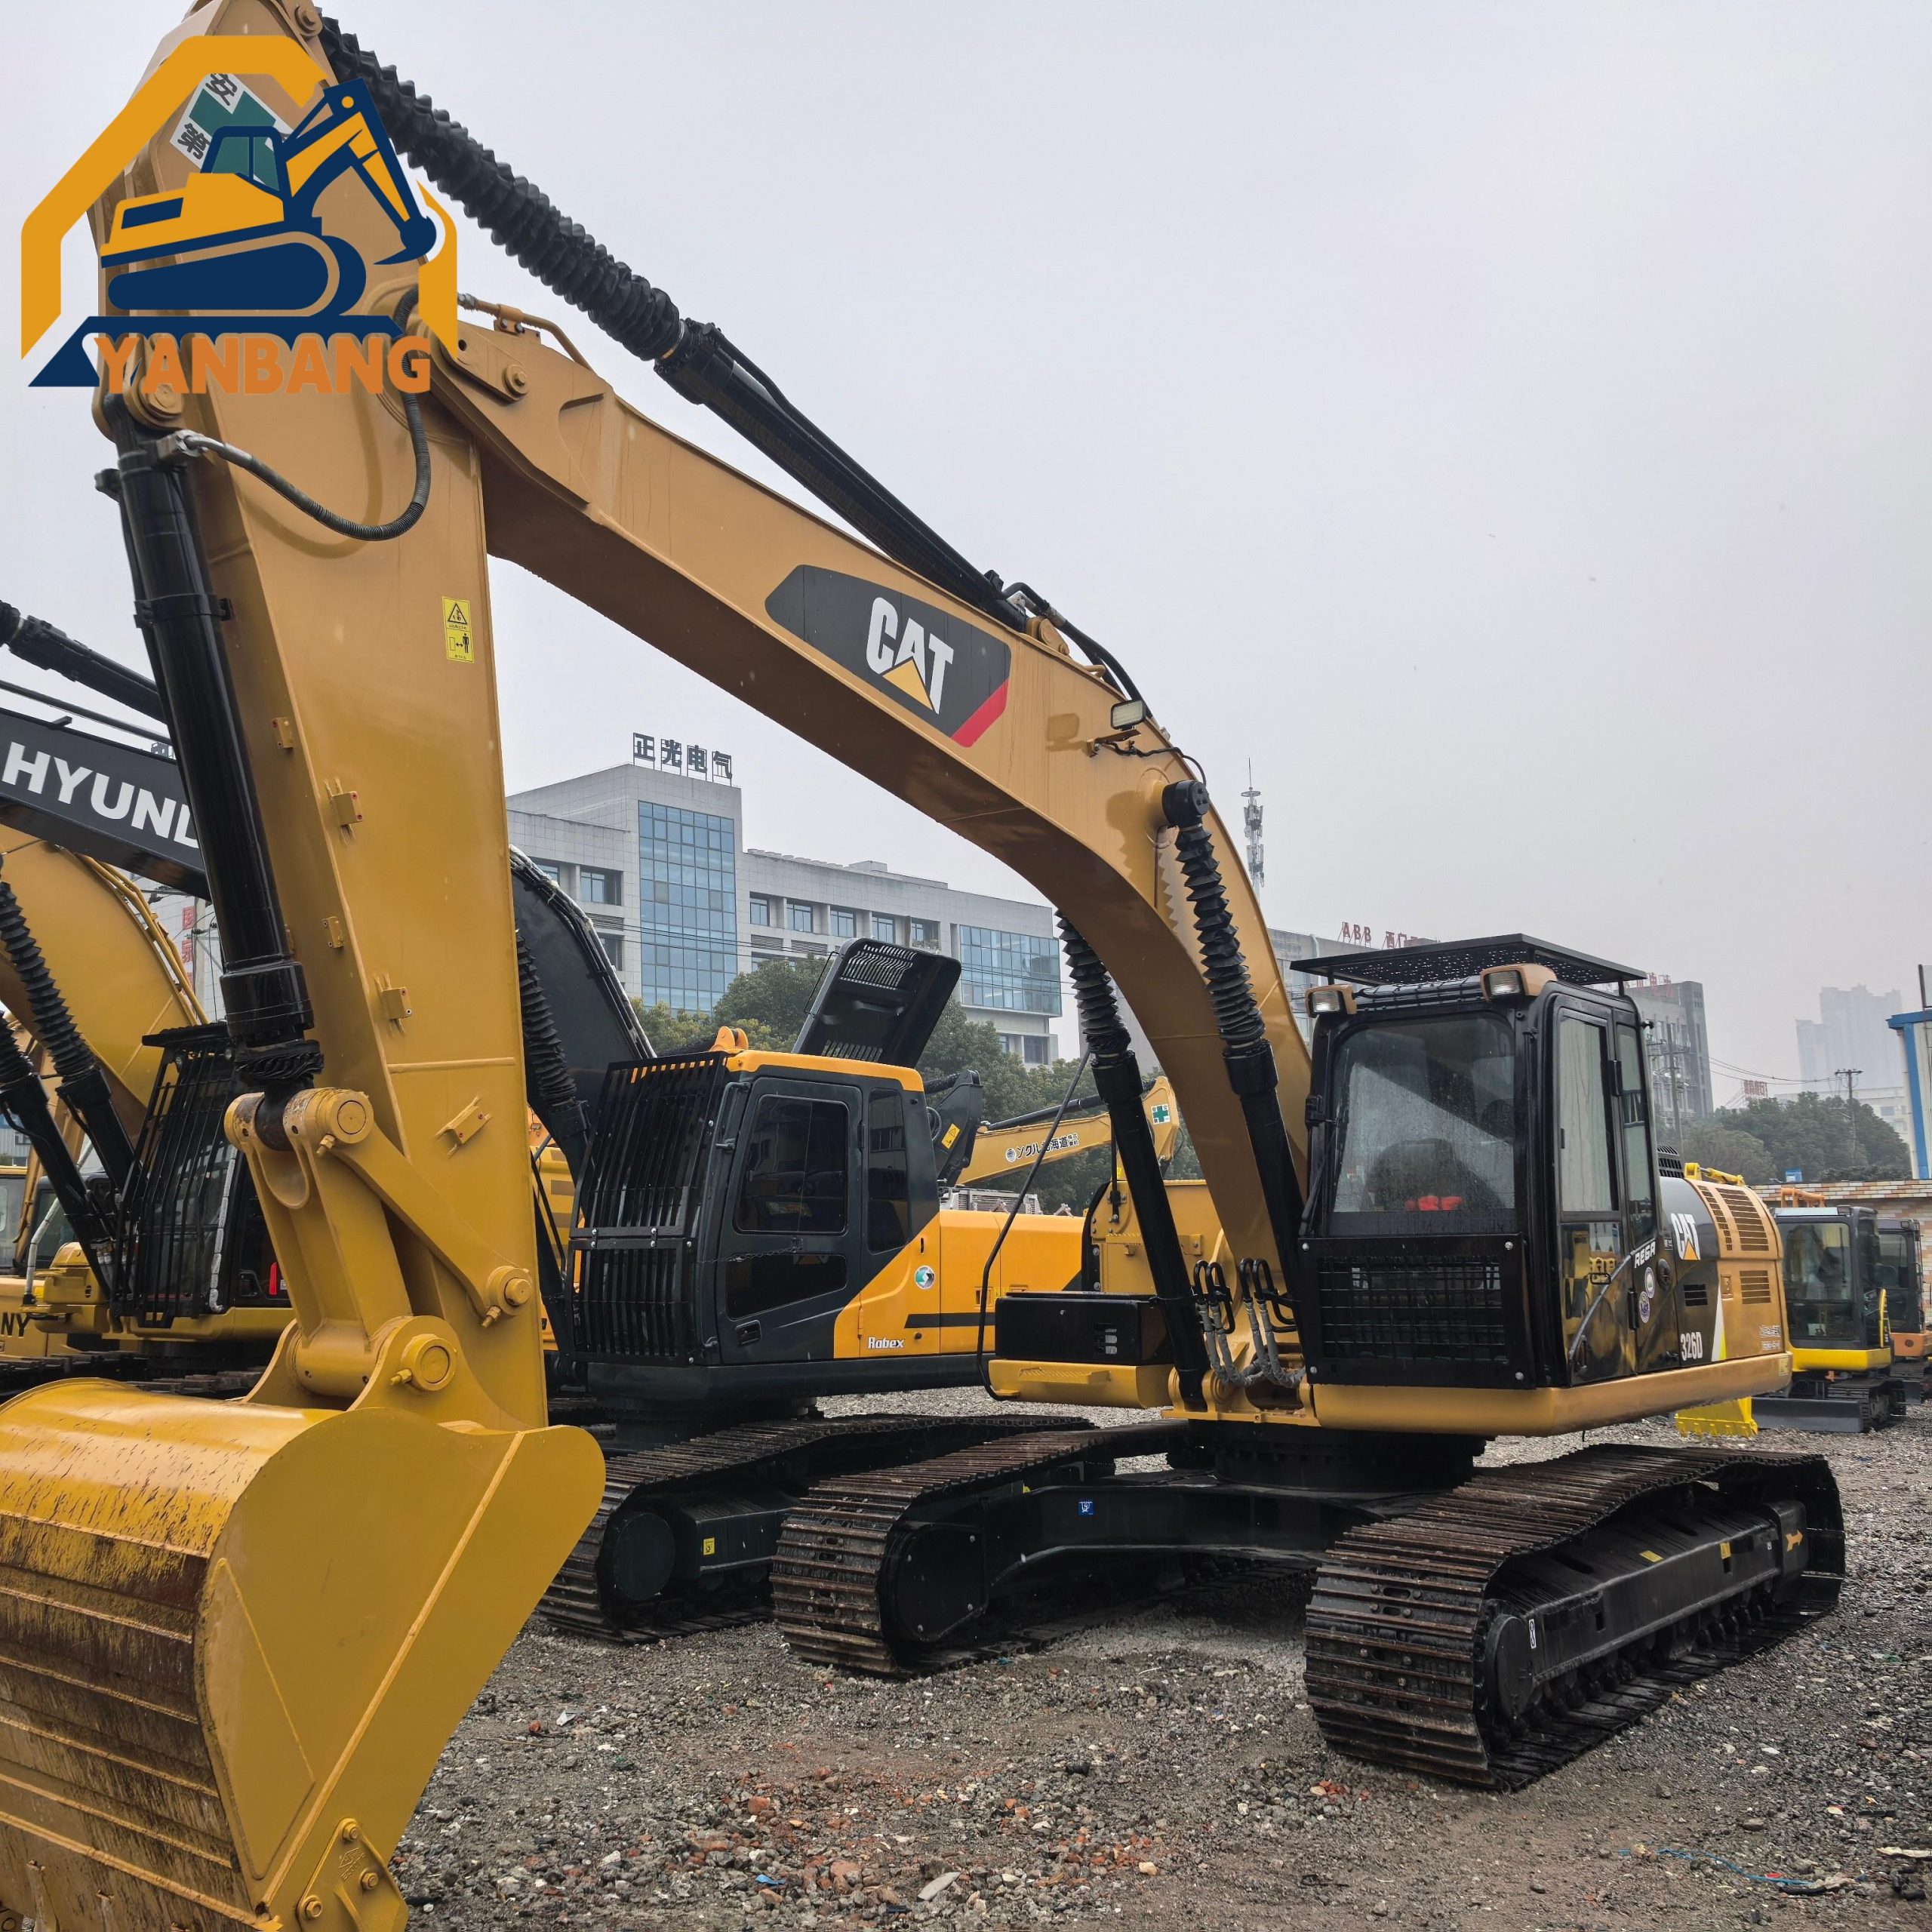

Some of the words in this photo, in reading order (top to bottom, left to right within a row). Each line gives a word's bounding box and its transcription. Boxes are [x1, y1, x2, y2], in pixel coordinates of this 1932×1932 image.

[866, 597, 954, 715] CAT
[633, 733, 732, 779] 正光电气
[1343, 921, 1371, 943] ABB
[1386, 931, 1419, 947] 西门
[1670, 1213, 1701, 1260] CAT
[1680, 1331, 1703, 1361] 326D
